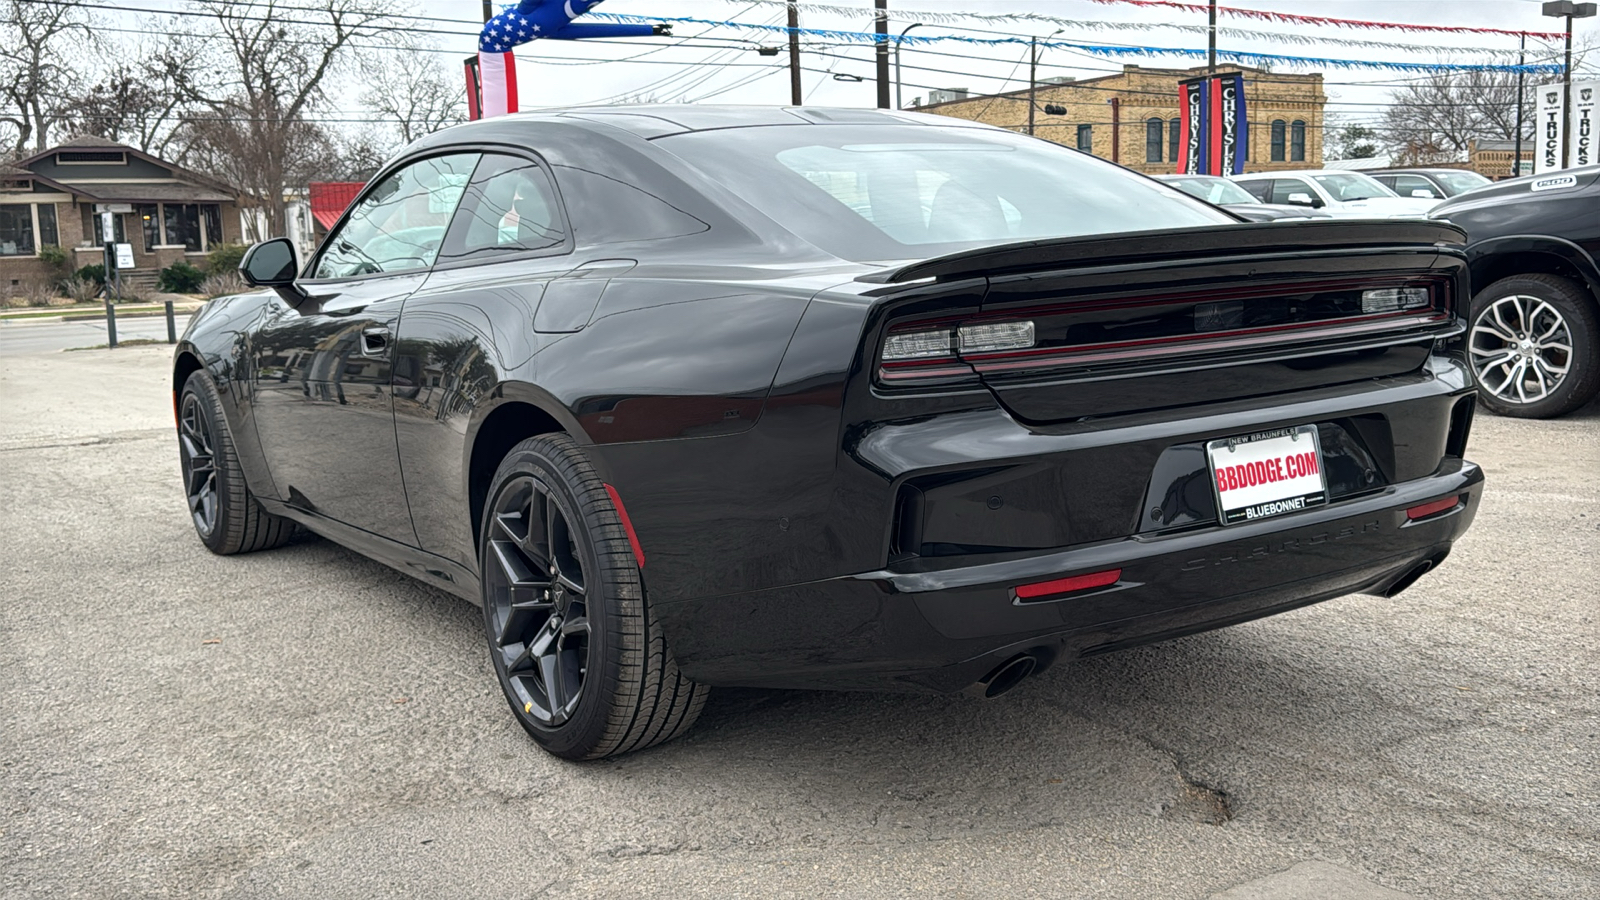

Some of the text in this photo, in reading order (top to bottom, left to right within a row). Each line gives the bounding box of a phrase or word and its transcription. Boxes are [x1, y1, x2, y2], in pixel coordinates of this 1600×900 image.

[1222, 88, 1236, 178] CHRYSLER
[1545, 112, 1557, 167] TRUCKS
[1578, 109, 1591, 165] TRUCKS
[1231, 429, 1295, 445] NEW BRAUNFELS
[1215, 451, 1319, 492] BBDODGE.COM
[1246, 497, 1305, 518] BLUEBONNET
